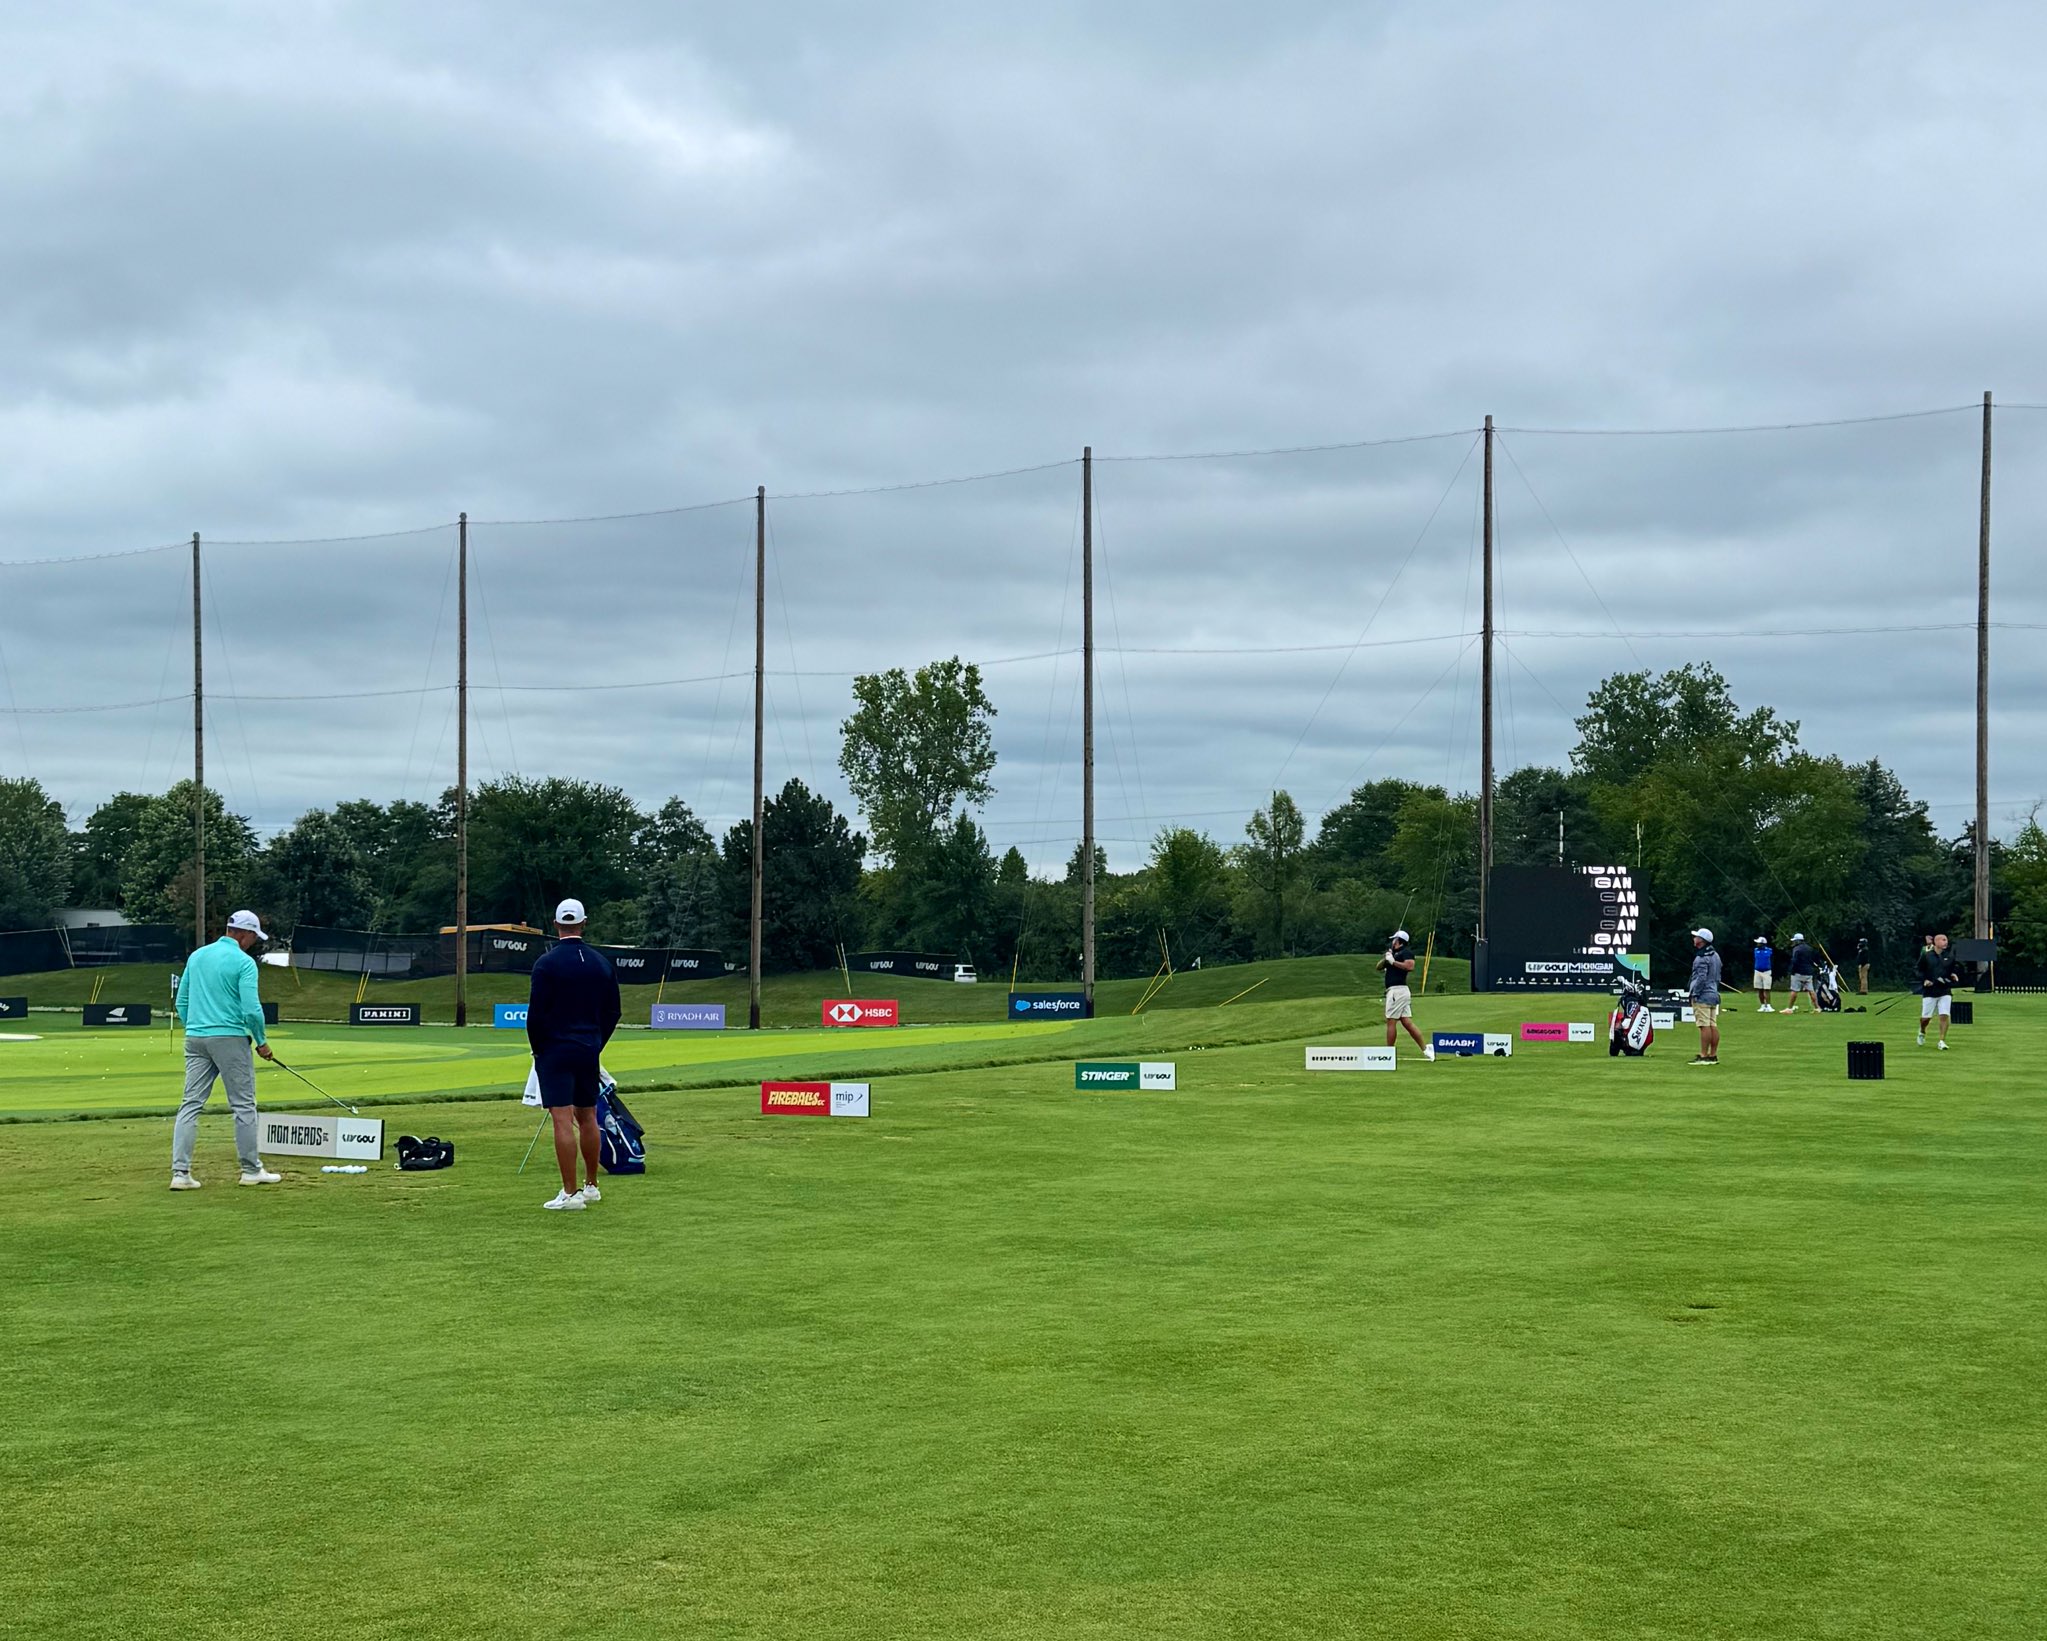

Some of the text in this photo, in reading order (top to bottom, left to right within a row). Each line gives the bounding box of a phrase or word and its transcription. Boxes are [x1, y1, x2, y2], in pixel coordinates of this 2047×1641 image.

[1033, 1000, 1080, 1012] salesforce
[504, 1011, 528, 1021] ara
[667, 1012, 720, 1021] RIYADH AIR
[865, 1008, 893, 1017] HSBC
[1438, 1039, 1476, 1047] SMASH
[1081, 1071, 1130, 1081] STINGER
[767, 1091, 820, 1106] FIREBALLS
[836, 1091, 854, 1104] mip
[267, 1124, 289, 1144] IRON
[290, 1126, 323, 1146] HEADS
